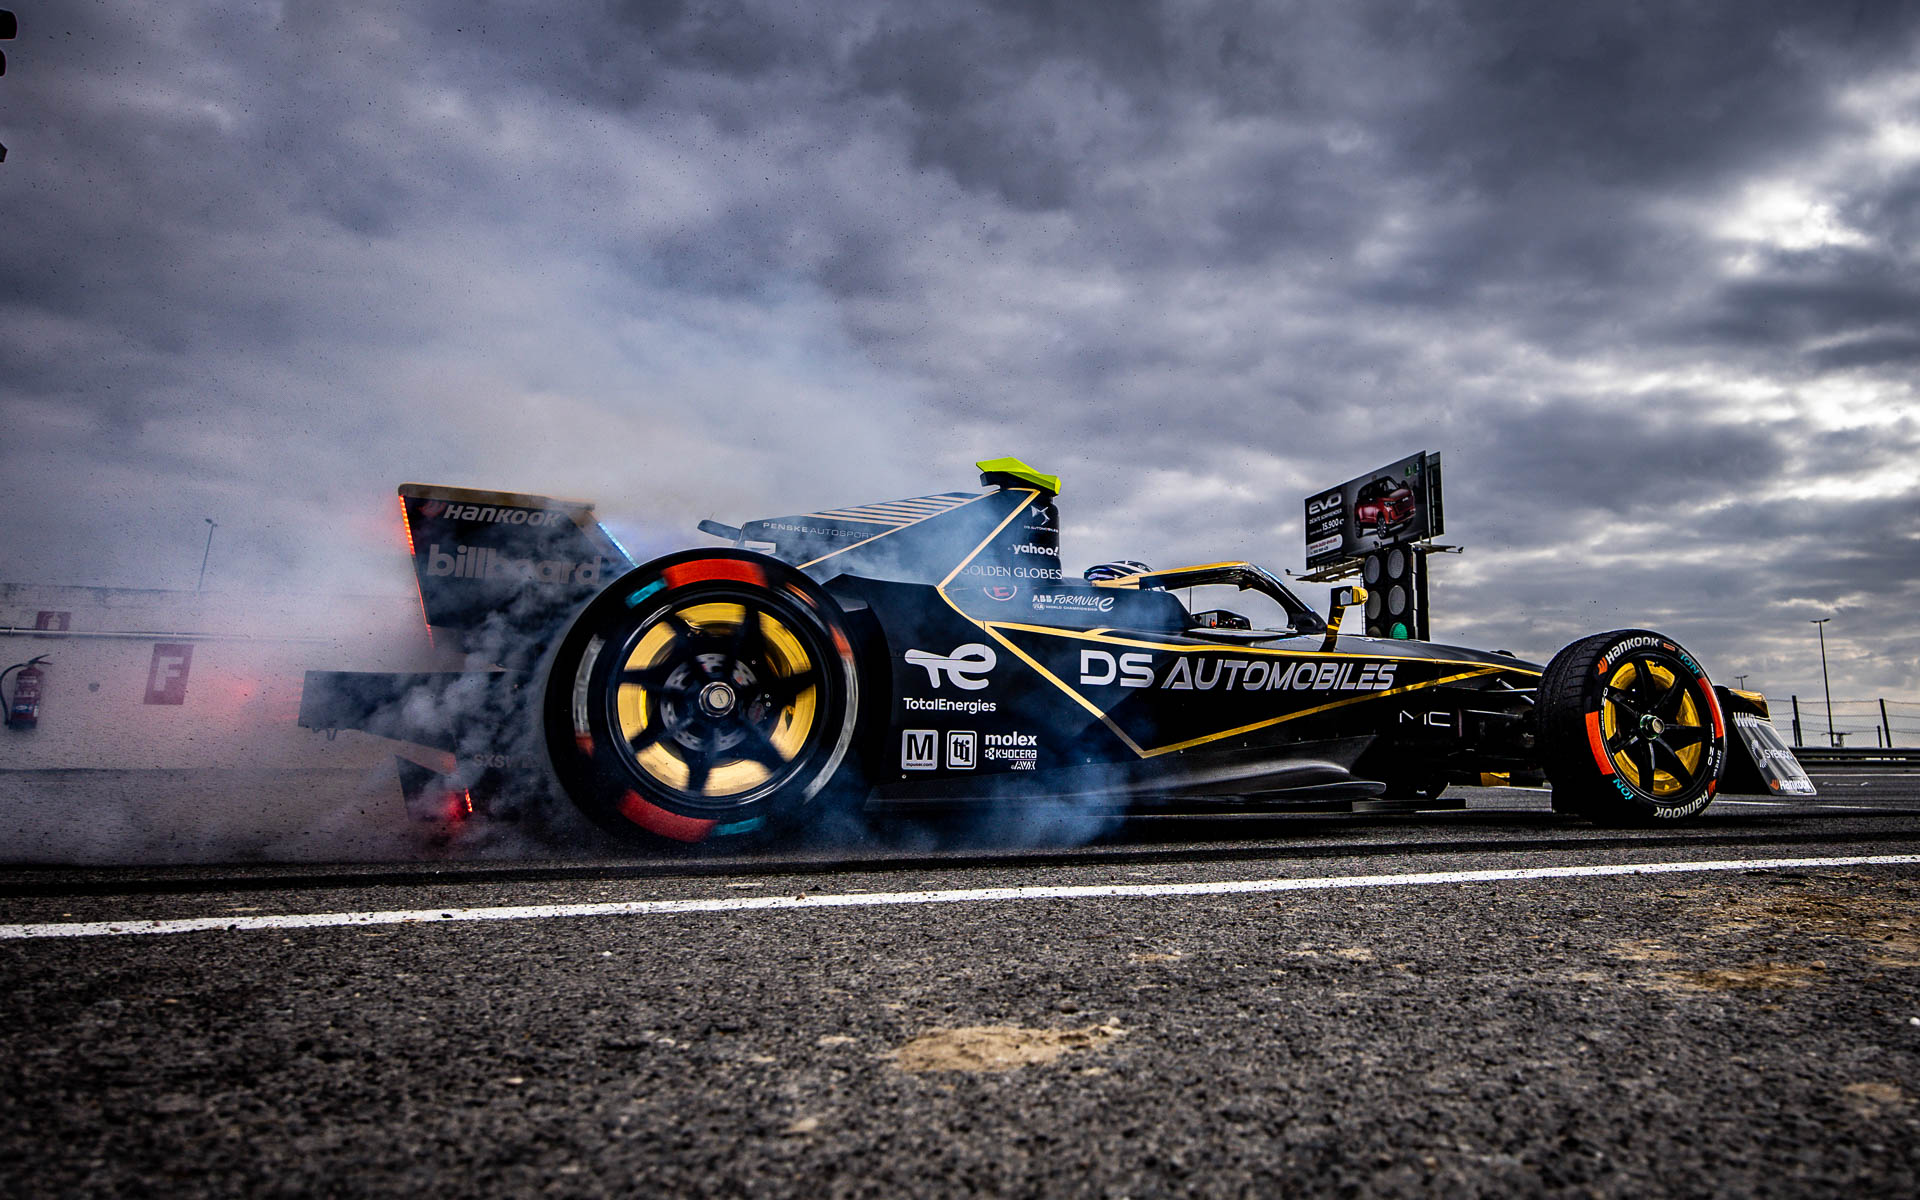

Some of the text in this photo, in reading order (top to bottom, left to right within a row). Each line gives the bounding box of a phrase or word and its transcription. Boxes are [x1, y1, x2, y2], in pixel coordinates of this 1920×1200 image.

[1308, 493, 1342, 515] EVO
[763, 522, 874, 539] PENSKE AUTOSPORT
[1012, 543, 1059, 556] yahoo!
[426, 543, 600, 585] billboard
[960, 565, 1062, 580] GOLDEN GLOBES
[1032, 595, 1053, 603] ABB
[1052, 595, 1100, 607] FORMULA
[153, 656, 184, 692] F
[1080, 649, 1398, 691] DS AUTOMOBILES
[903, 697, 997, 715] TotalEnergies
[984, 731, 1038, 746] molex
[995, 749, 1038, 759] KYOCERA
